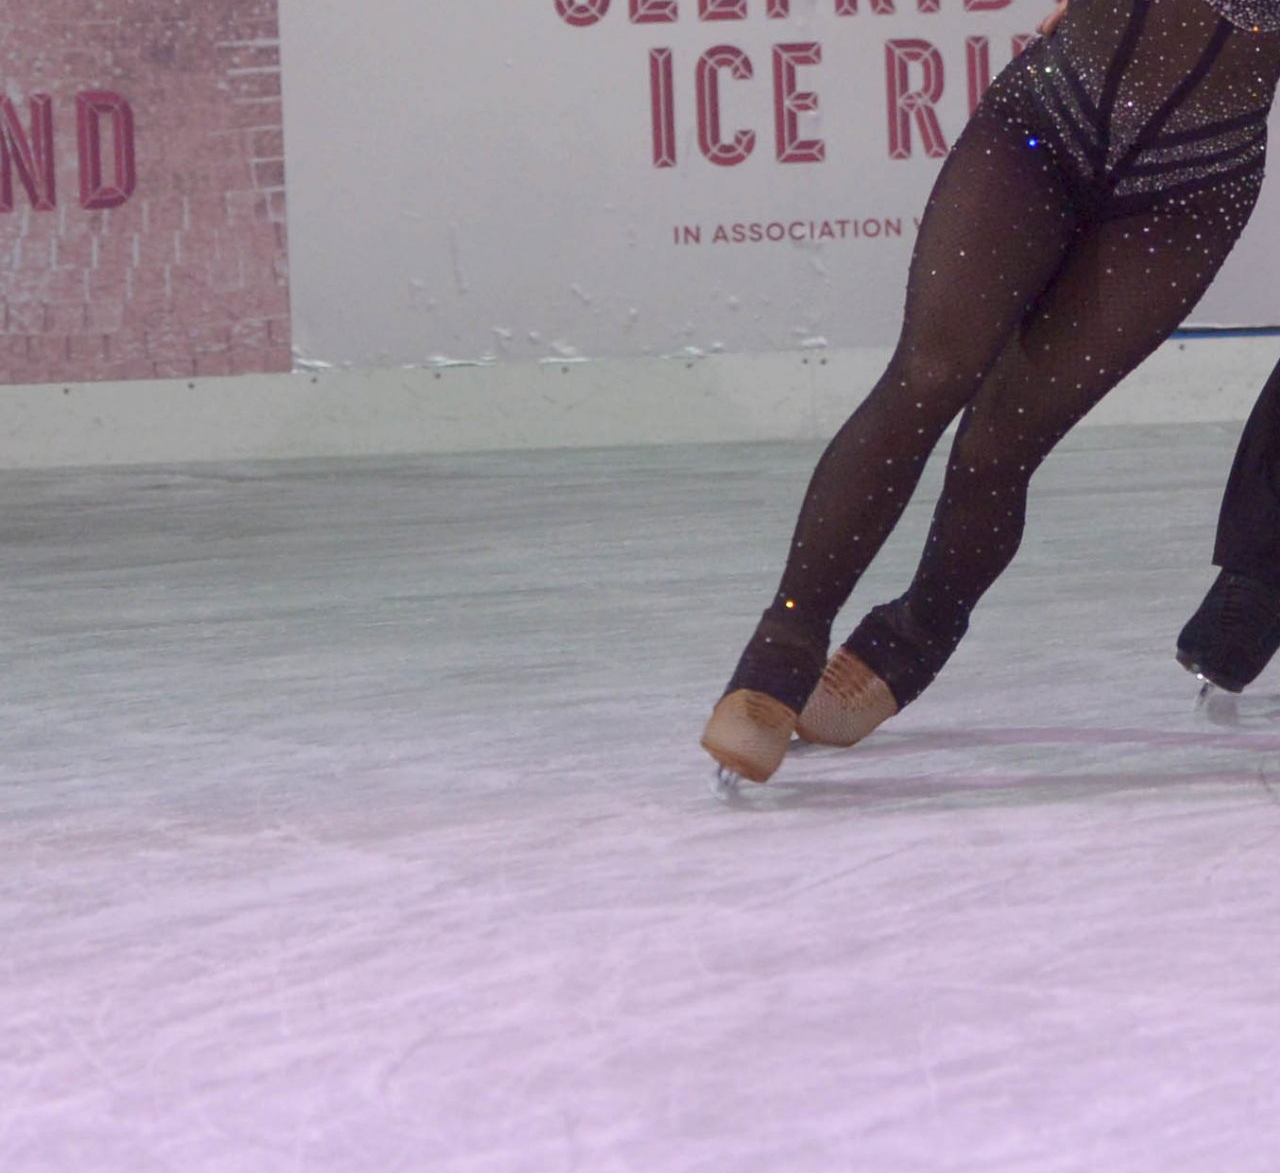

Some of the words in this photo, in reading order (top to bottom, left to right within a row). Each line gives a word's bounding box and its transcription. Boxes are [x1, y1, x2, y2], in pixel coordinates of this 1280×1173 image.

[649, 42, 825, 169] ICE
[885, 35, 1034, 160] RI
[673, 224, 700, 245] IN
[713, 217, 902, 243] ASSOCIATION
